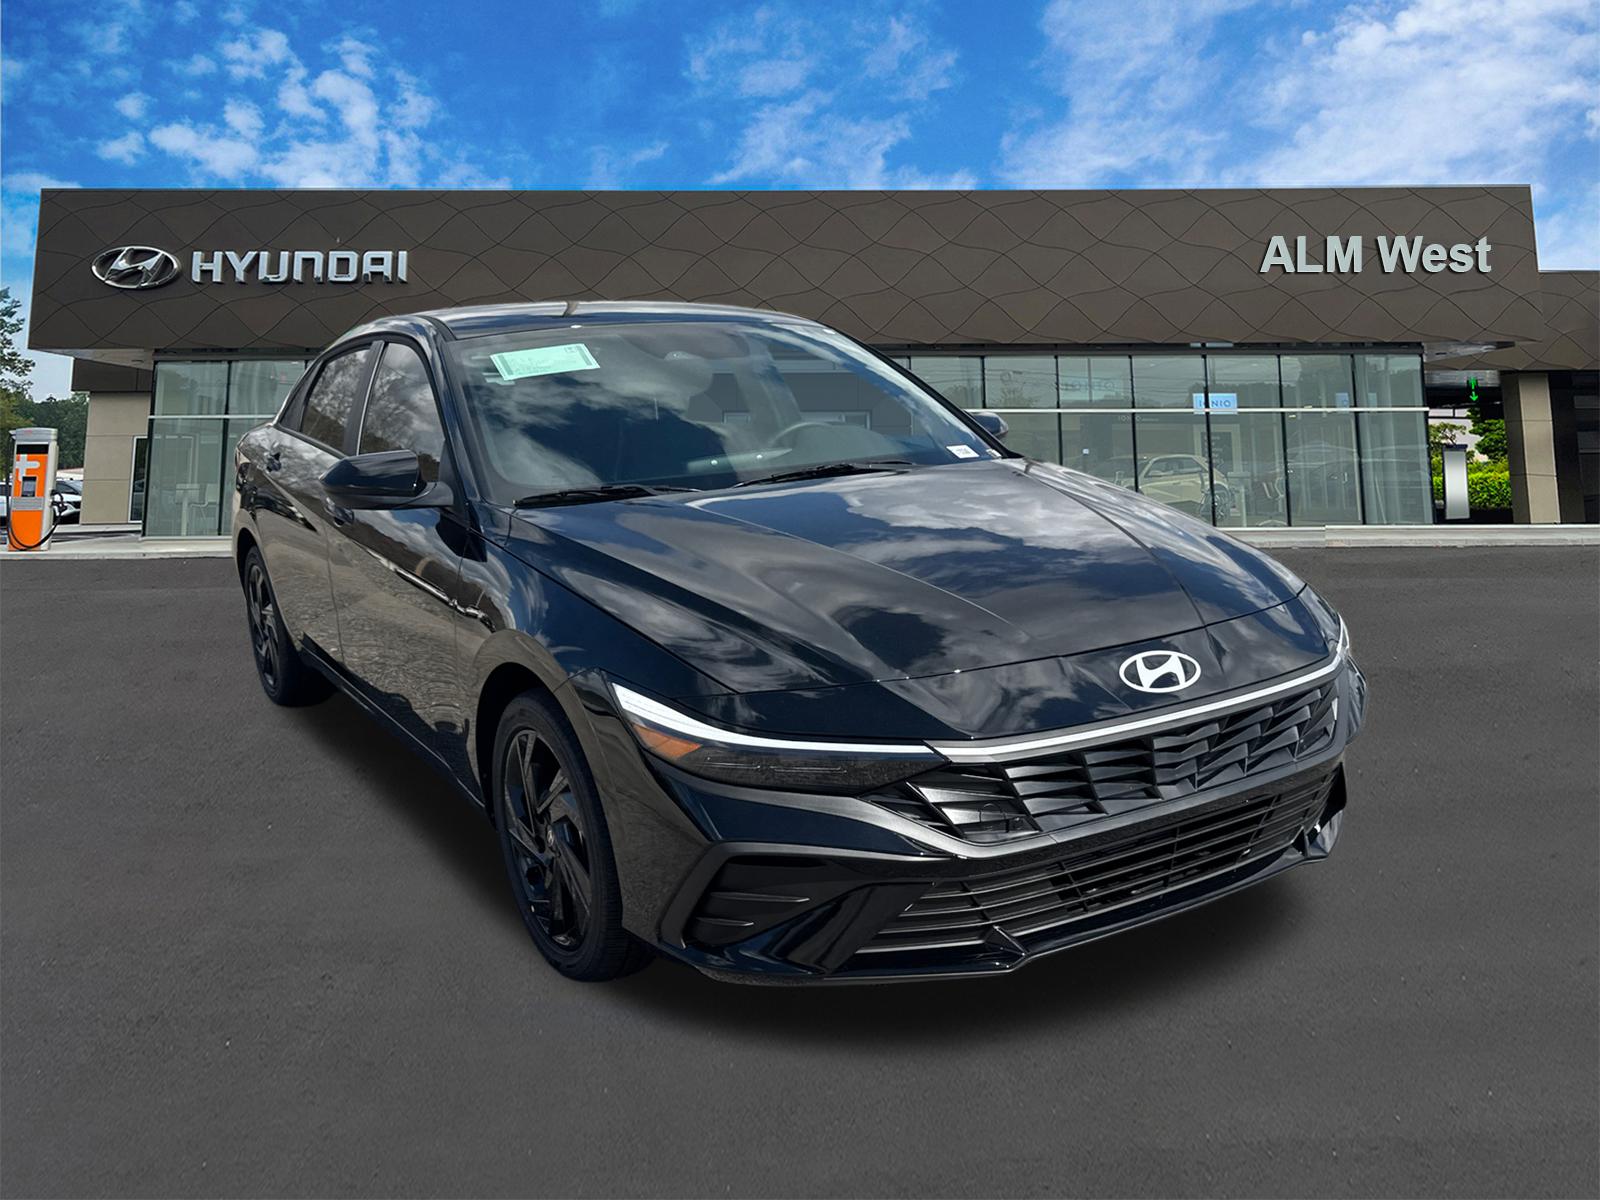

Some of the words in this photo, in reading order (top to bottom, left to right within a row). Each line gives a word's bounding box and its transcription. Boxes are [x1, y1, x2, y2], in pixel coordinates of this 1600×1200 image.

[191, 250, 408, 284] HYUNDAI
[1259, 235, 1363, 273] ALM
[1377, 235, 1492, 273] West
